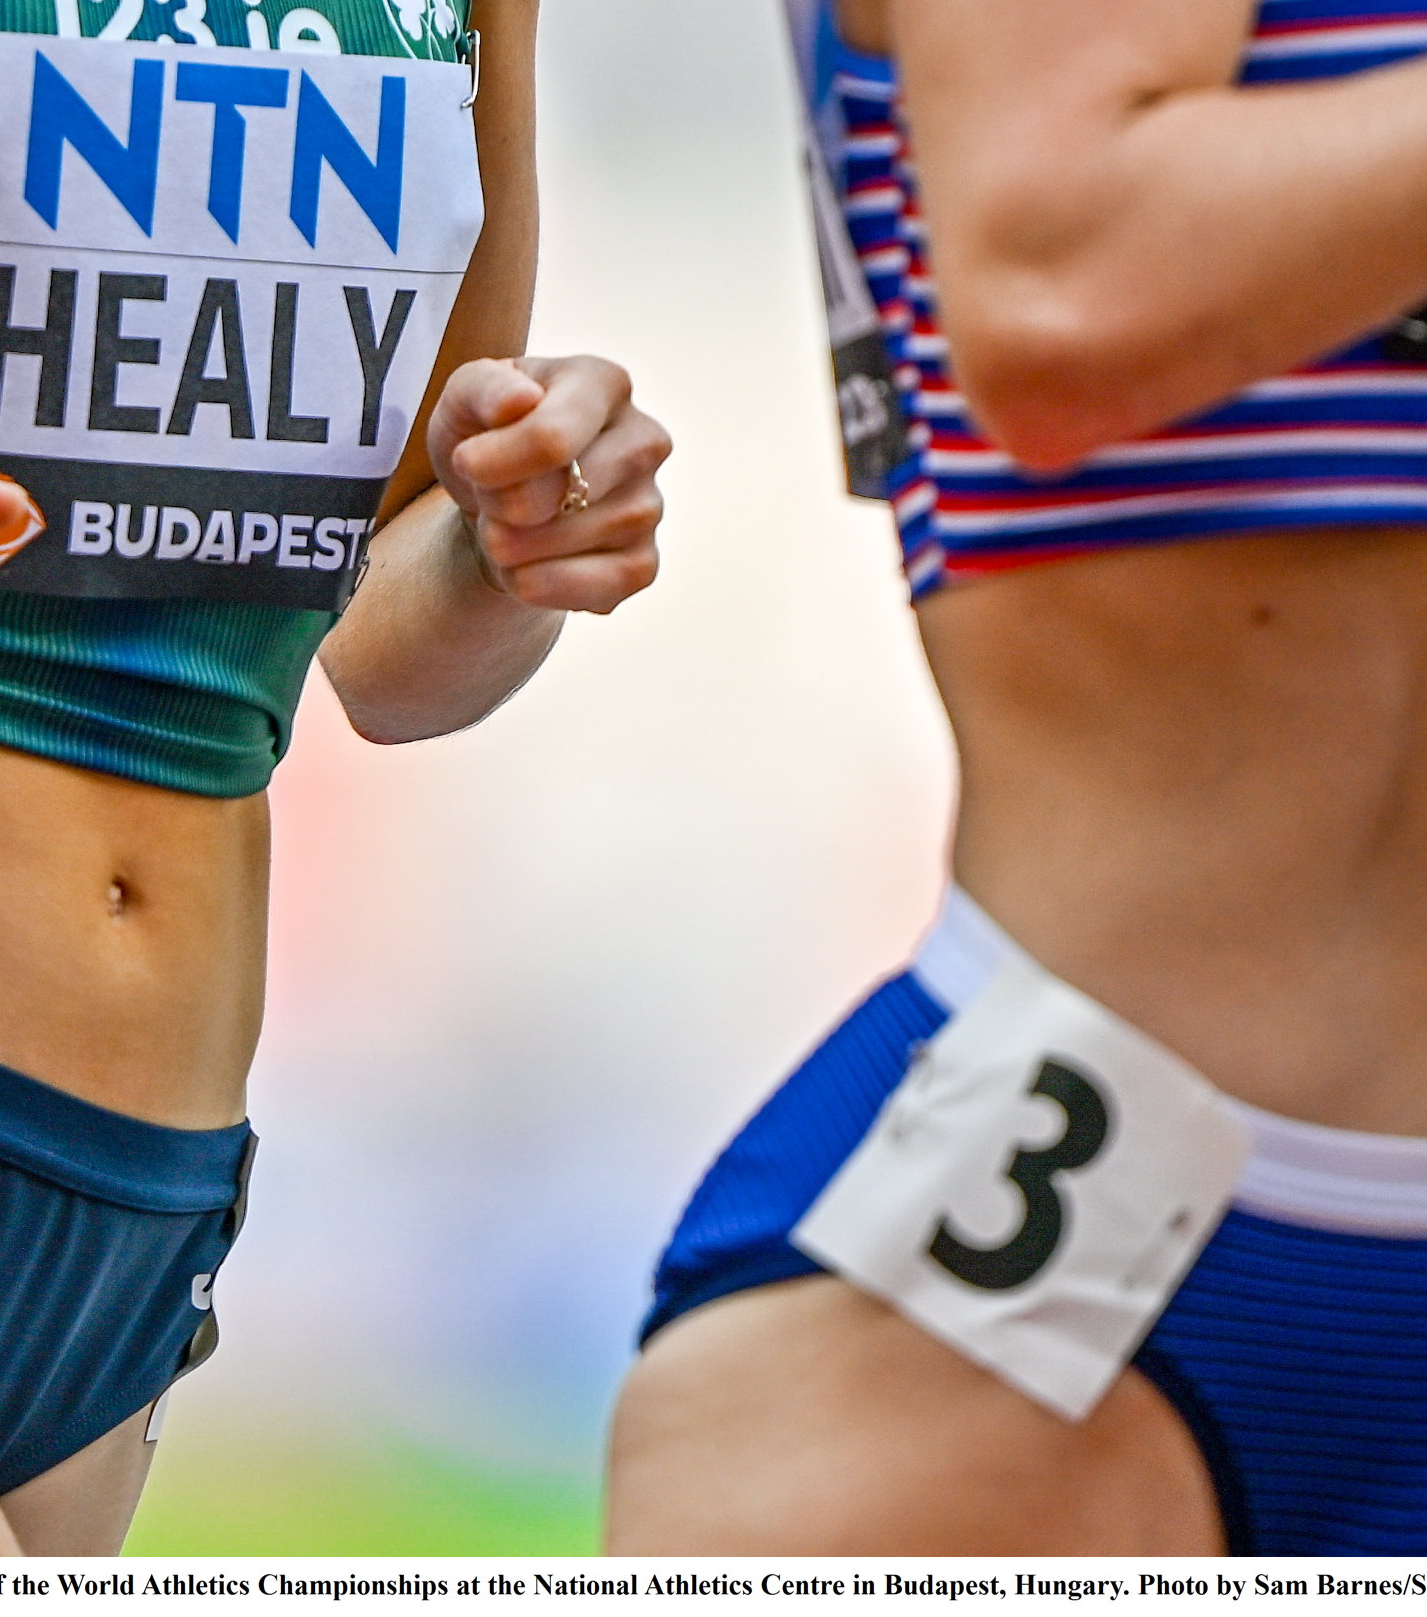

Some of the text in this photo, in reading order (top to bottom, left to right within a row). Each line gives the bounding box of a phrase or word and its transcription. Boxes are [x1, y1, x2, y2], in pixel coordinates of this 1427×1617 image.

[22, 49, 408, 256] NTN
[68, 499, 377, 571] BUDAPEST
[924, 1055, 1114, 1294] 3
